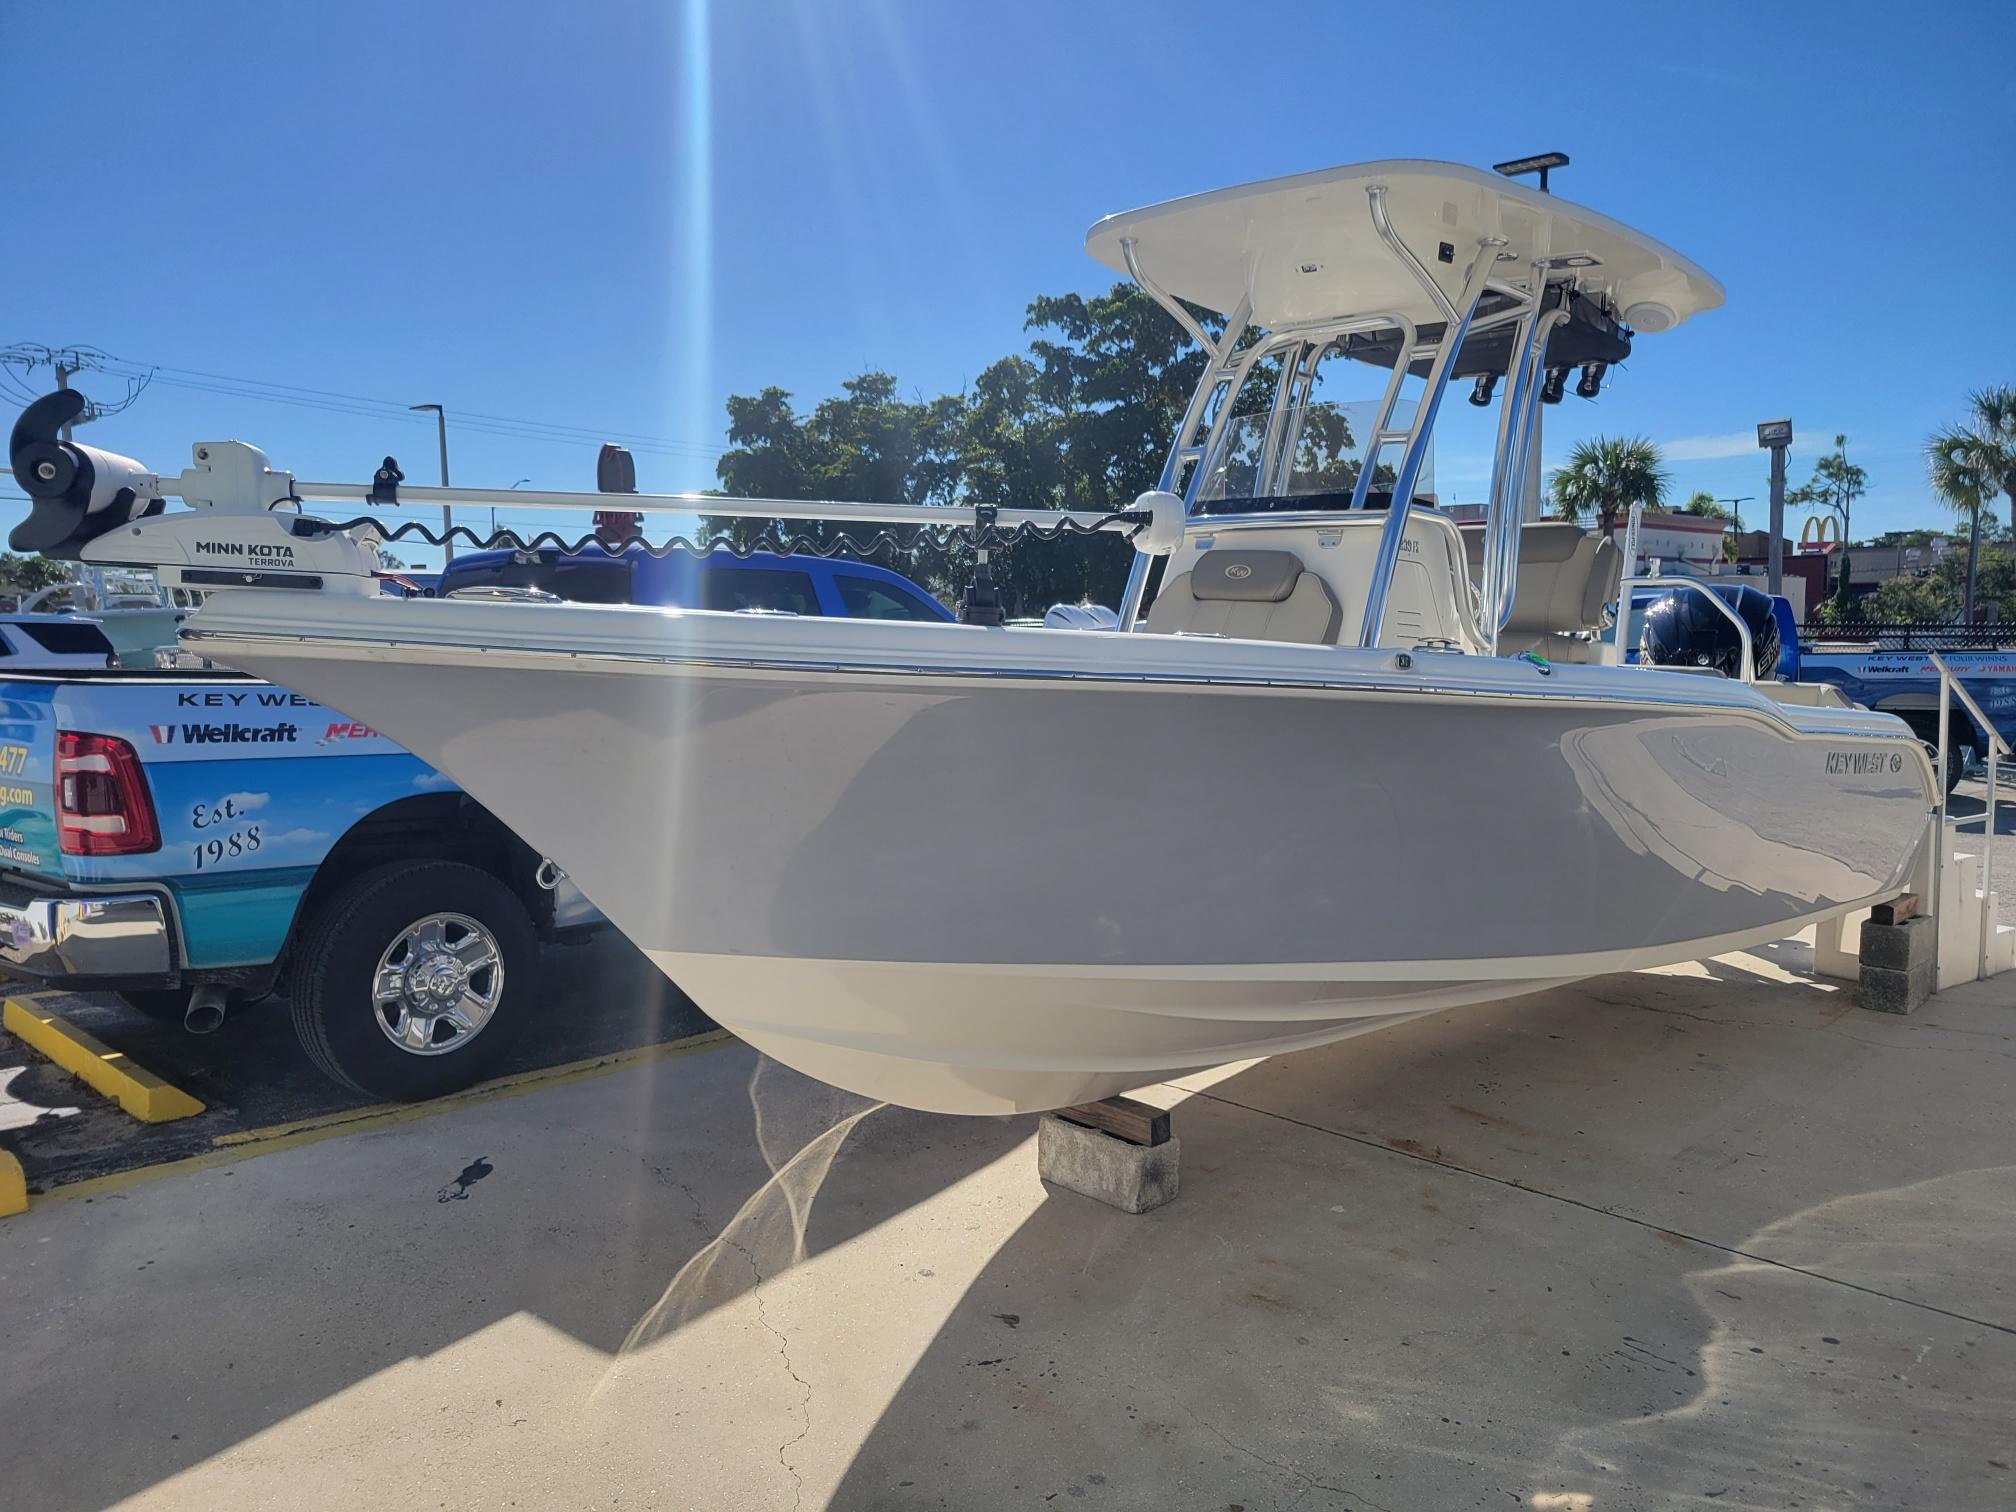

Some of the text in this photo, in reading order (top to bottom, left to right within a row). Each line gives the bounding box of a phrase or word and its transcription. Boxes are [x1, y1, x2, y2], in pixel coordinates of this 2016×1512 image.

[195, 541, 294, 558] MINN KOTA
[248, 557, 294, 567] TERROVA
[1868, 665, 1910, 673] Wellcraft
[178, 693, 248, 707] KEY
[182, 722, 298, 744] Wellcraft
[192, 798, 245, 829] Est.
[13, 848, 40, 865] Consoles
[193, 826, 261, 870] 1988
